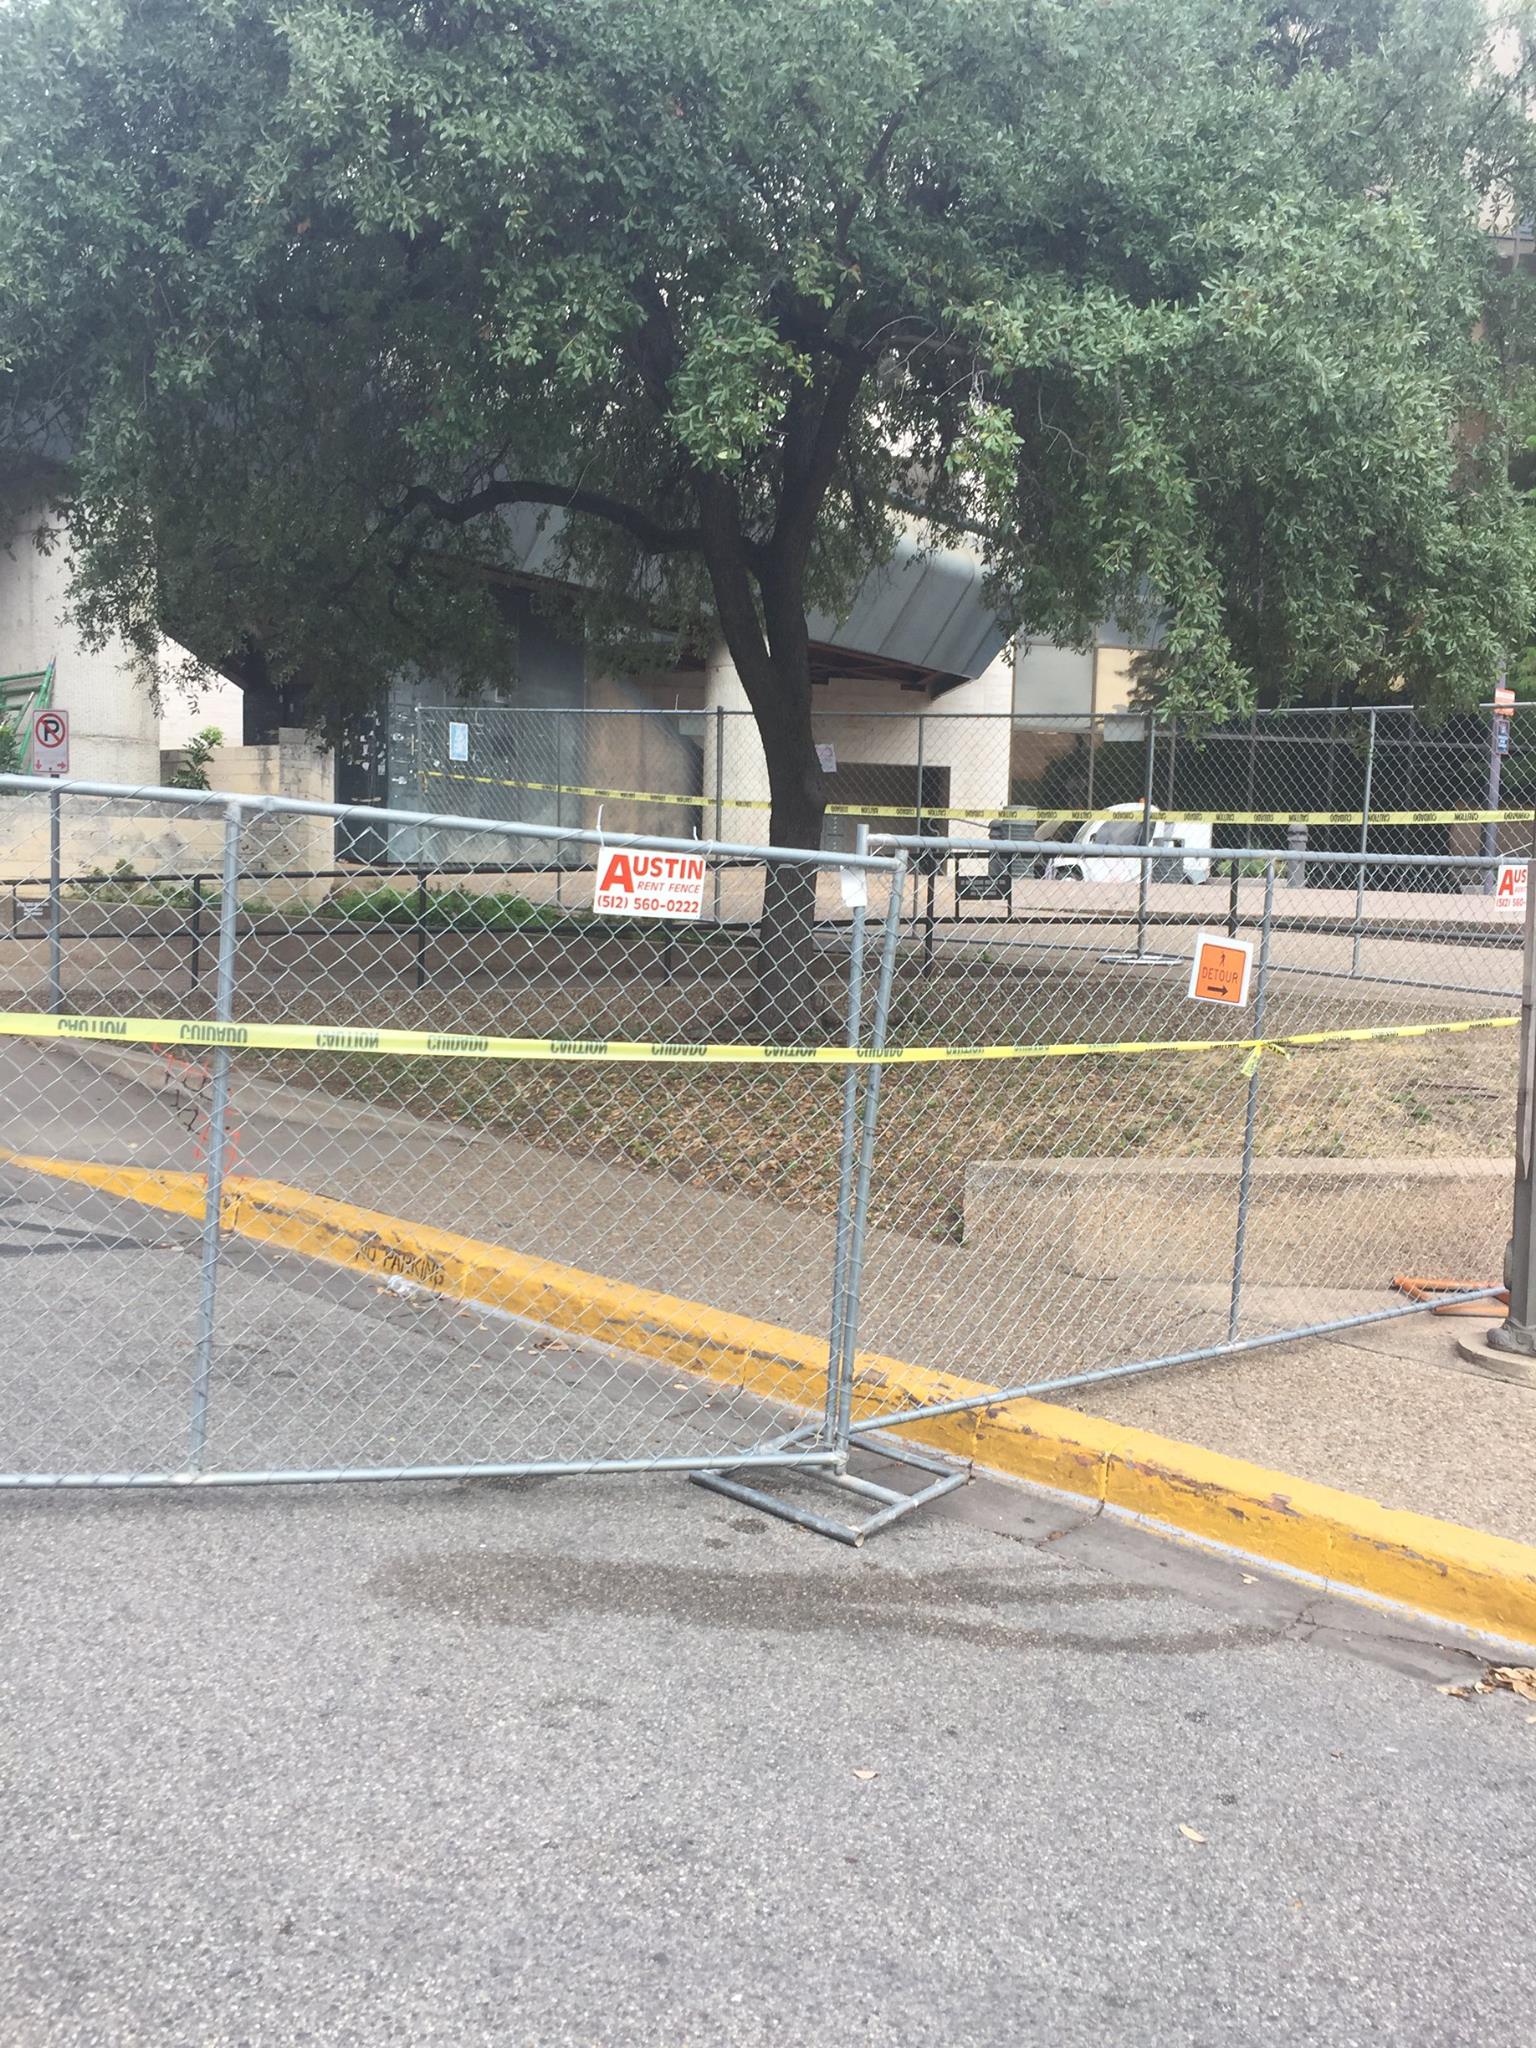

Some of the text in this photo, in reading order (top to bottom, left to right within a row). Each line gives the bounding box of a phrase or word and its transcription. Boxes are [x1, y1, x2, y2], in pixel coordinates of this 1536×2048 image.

[599, 854, 704, 893] AUSTIN
[1498, 869, 1527, 896] AUS
[637, 881, 701, 894] RENT FENCE
[597, 895, 699, 913] (512) 560-0222
[1202, 966, 1238, 984] DETOUR
[383, 1250, 445, 1286] PARKING
